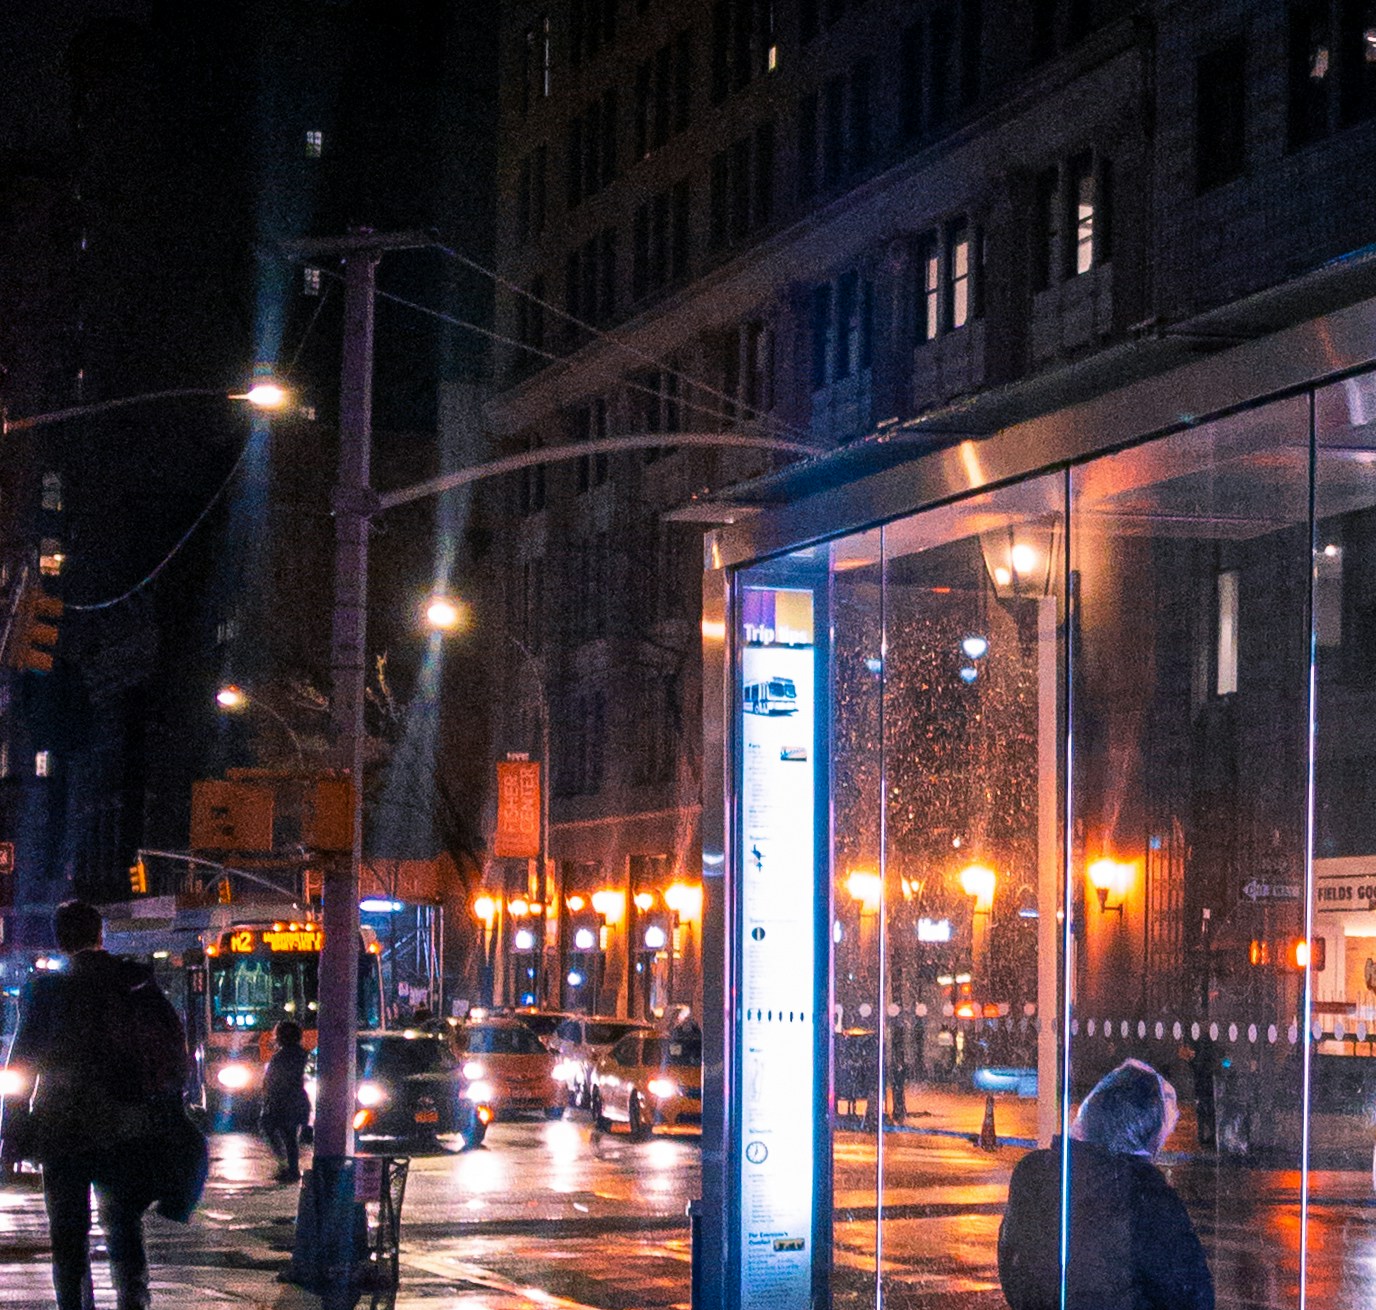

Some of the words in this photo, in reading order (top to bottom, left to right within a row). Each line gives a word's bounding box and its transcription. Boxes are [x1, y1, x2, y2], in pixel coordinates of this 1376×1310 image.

[743, 623, 775, 646] Trip
[520, 767, 535, 833] CENTER
[1317, 885, 1353, 902] FIELDS
